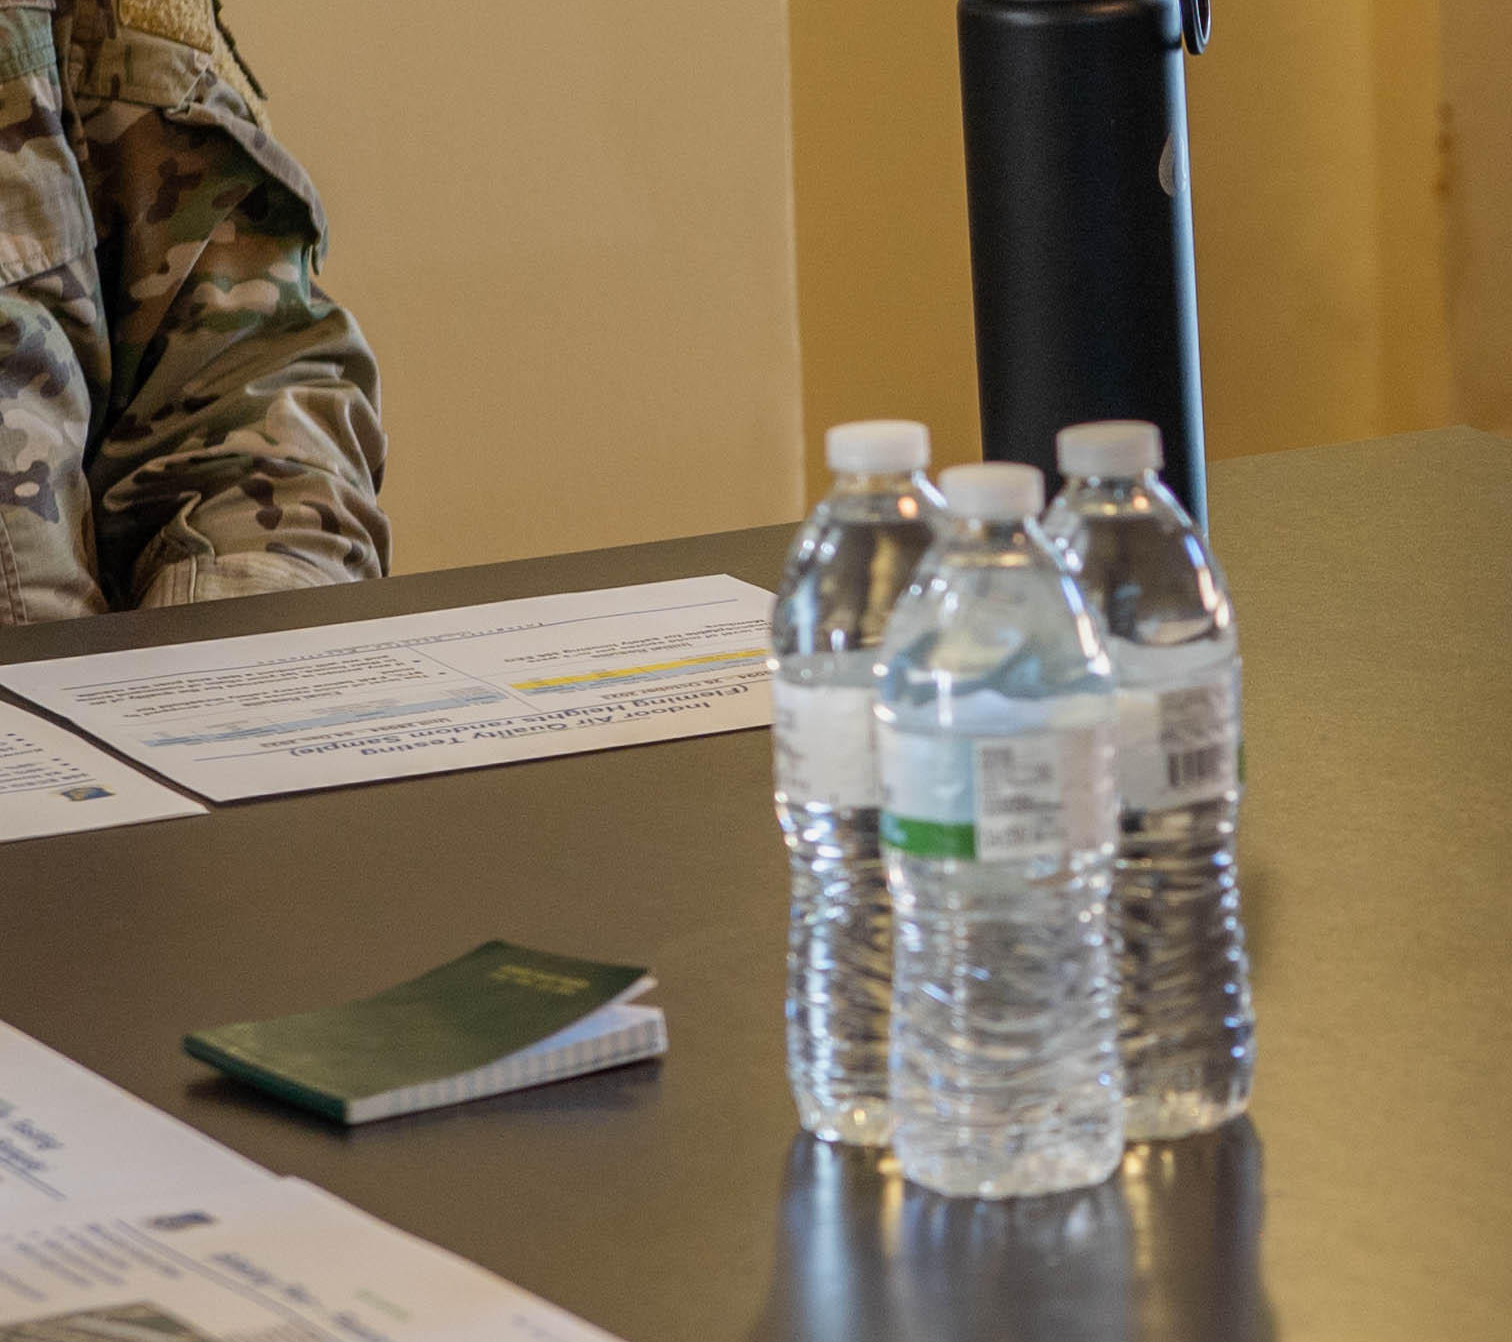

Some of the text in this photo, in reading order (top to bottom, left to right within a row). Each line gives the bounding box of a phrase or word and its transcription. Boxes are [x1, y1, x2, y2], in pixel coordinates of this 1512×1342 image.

[524, 703, 625, 722] Heights
[360, 701, 710, 757] Indoor Air Quality Testing
[409, 720, 512, 738] random
[289, 734, 399, 757] Sample)
